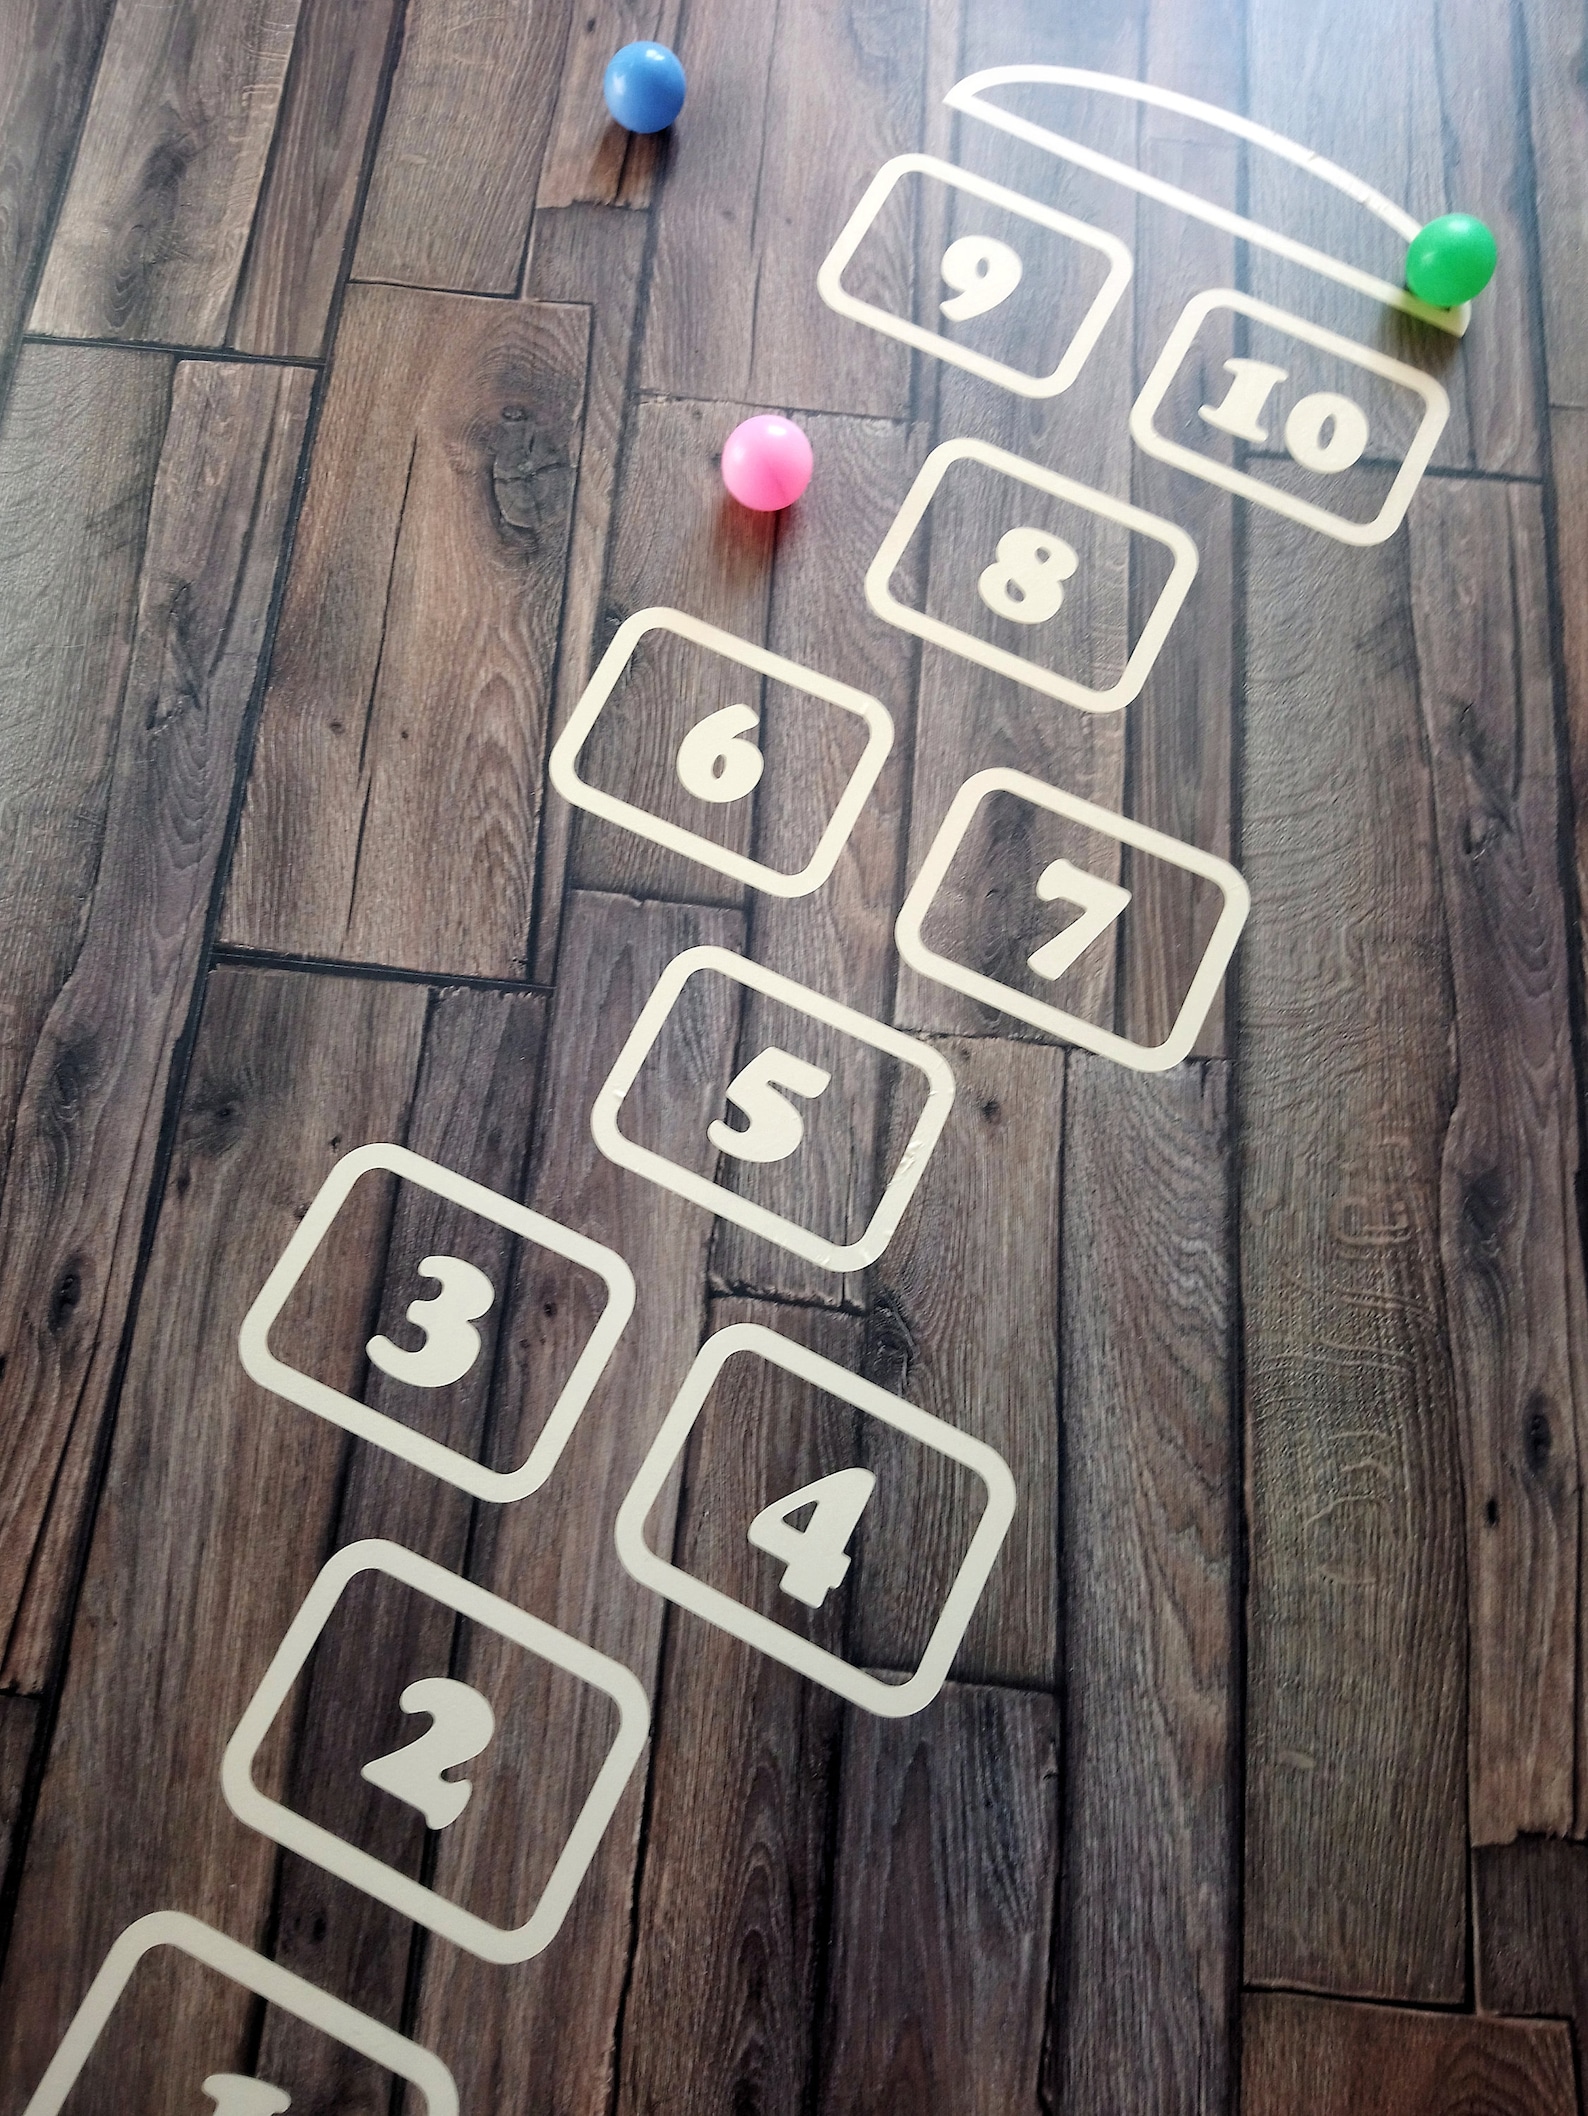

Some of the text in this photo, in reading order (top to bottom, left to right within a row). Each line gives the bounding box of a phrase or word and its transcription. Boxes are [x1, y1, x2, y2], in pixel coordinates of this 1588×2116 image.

[939, 234, 1023, 322] 9
[1198, 357, 1369, 474] 10
[977, 526, 1079, 624] 8
[676, 703, 764, 804] 6
[1027, 858, 1132, 981] 7
[707, 1046, 832, 1163] 5
[366, 1255, 495, 1388] 3
[747, 1467, 877, 1609] 4
[360, 1677, 496, 1830] 2
